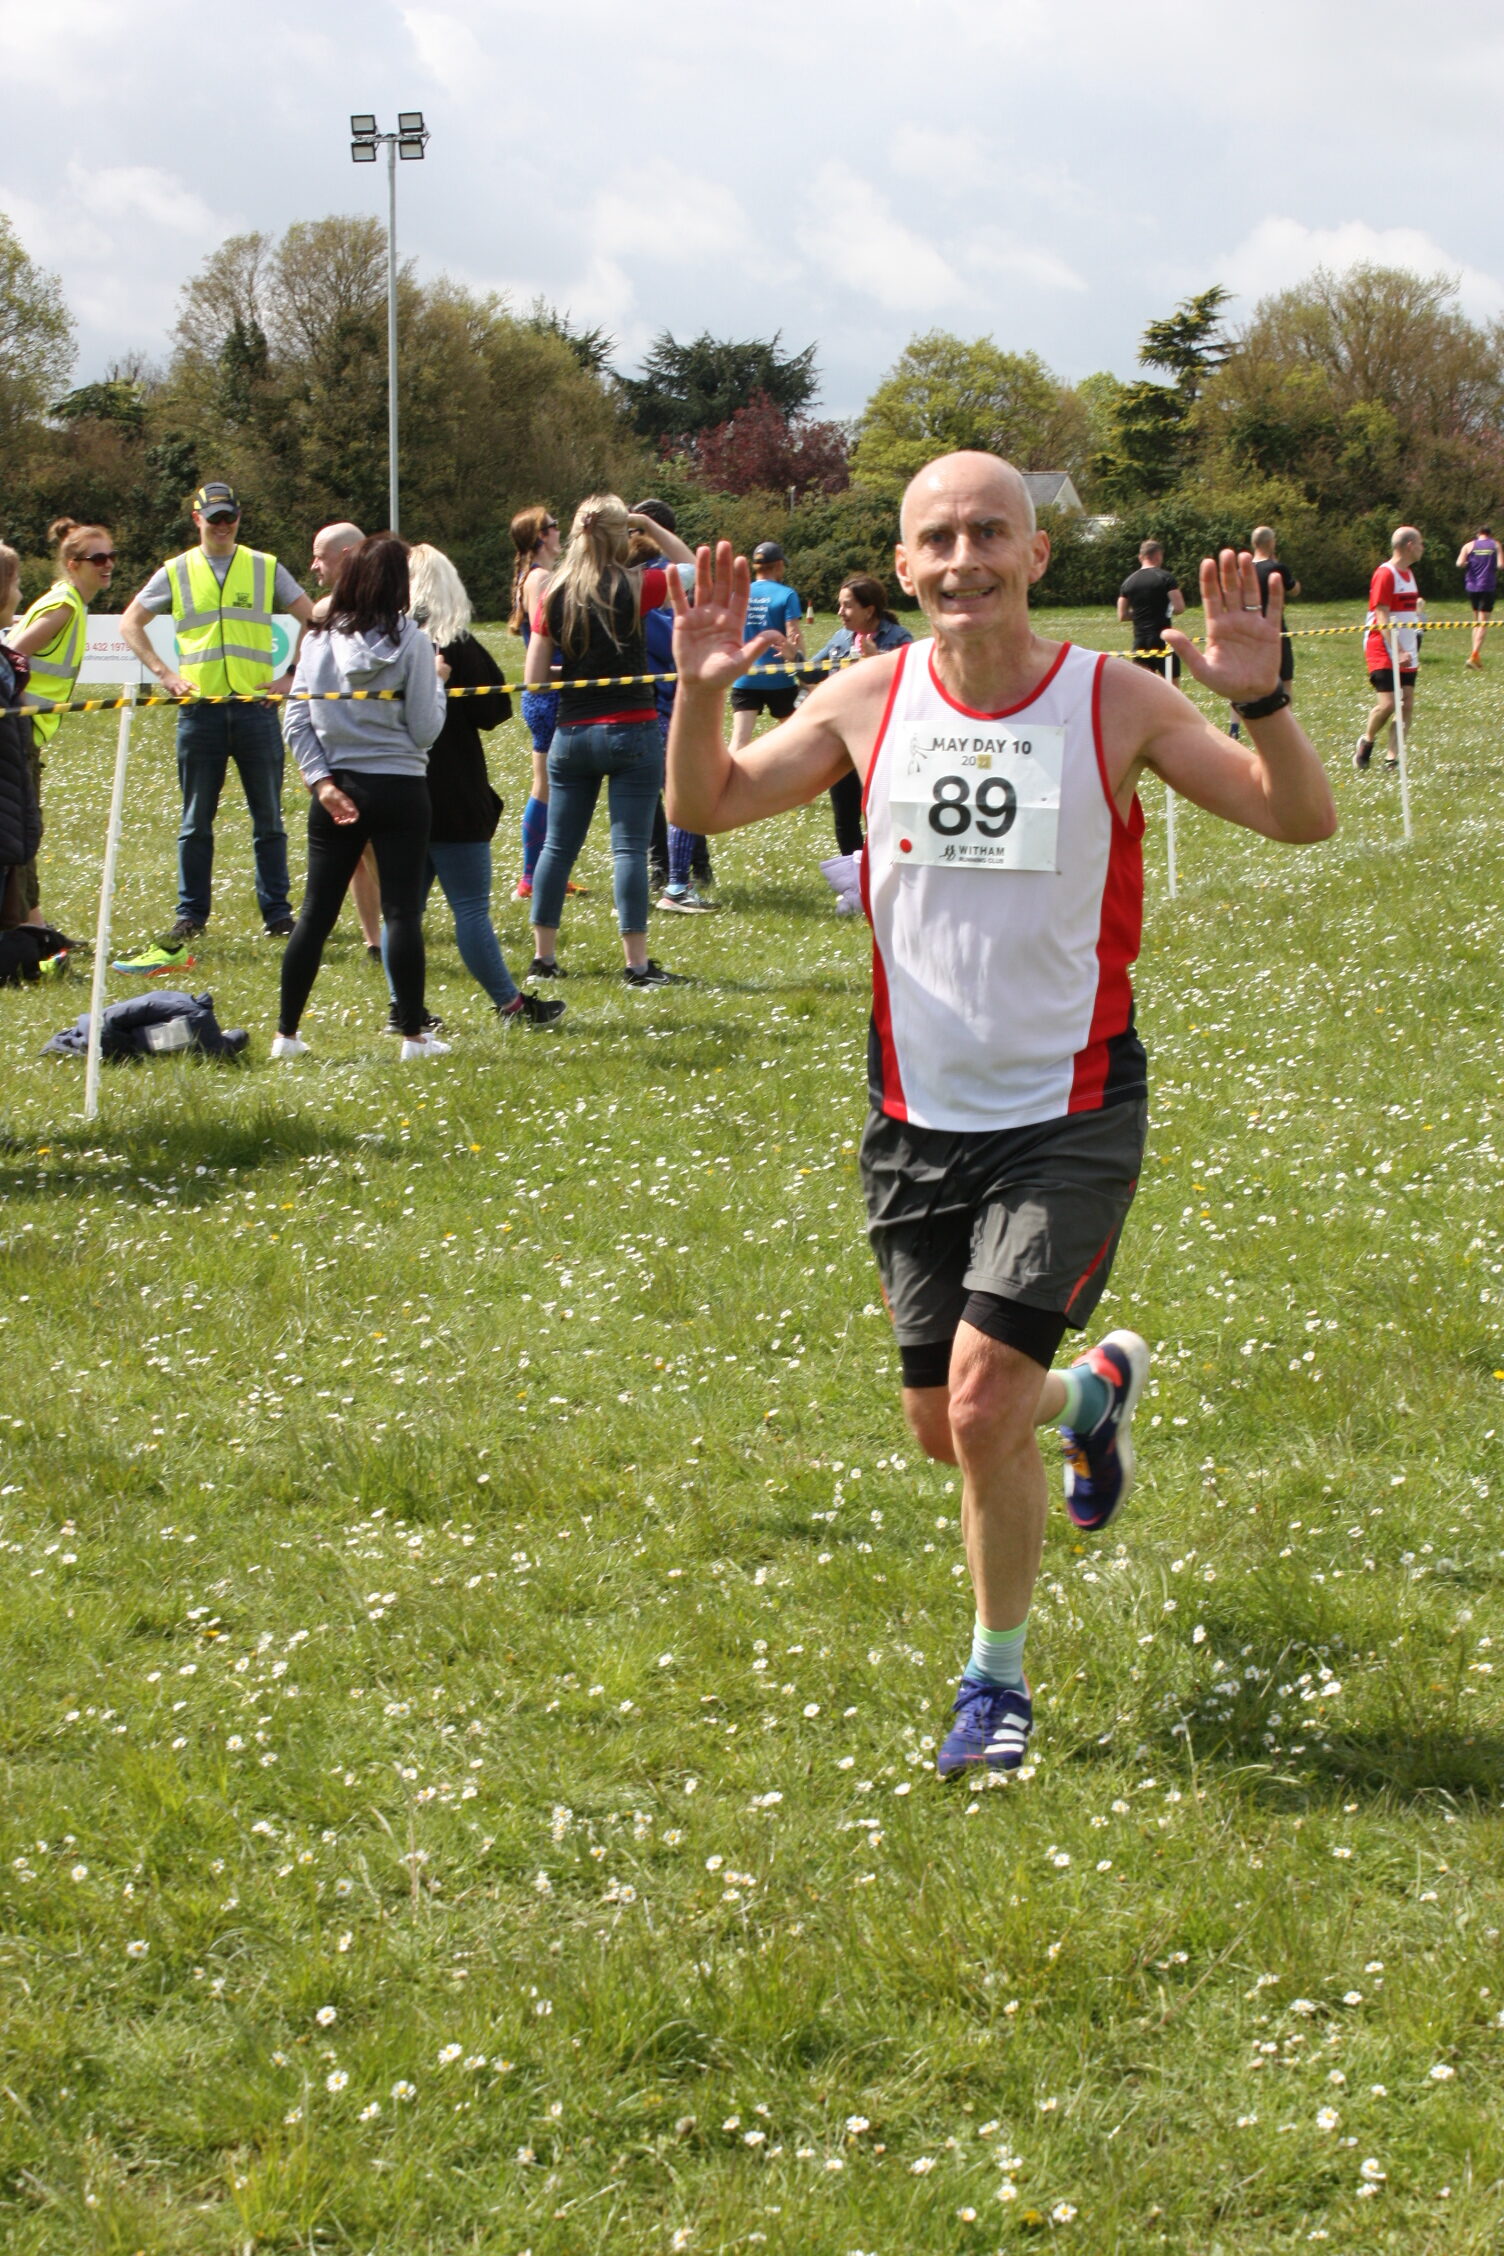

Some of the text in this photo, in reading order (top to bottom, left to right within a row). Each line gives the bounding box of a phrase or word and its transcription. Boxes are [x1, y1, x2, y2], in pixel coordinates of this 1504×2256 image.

[92, 643, 108, 651] 432
[932, 737, 1032, 755] MAY DAY 10
[928, 775, 1017, 838] 89
[959, 845, 1005, 856] WITHAM
